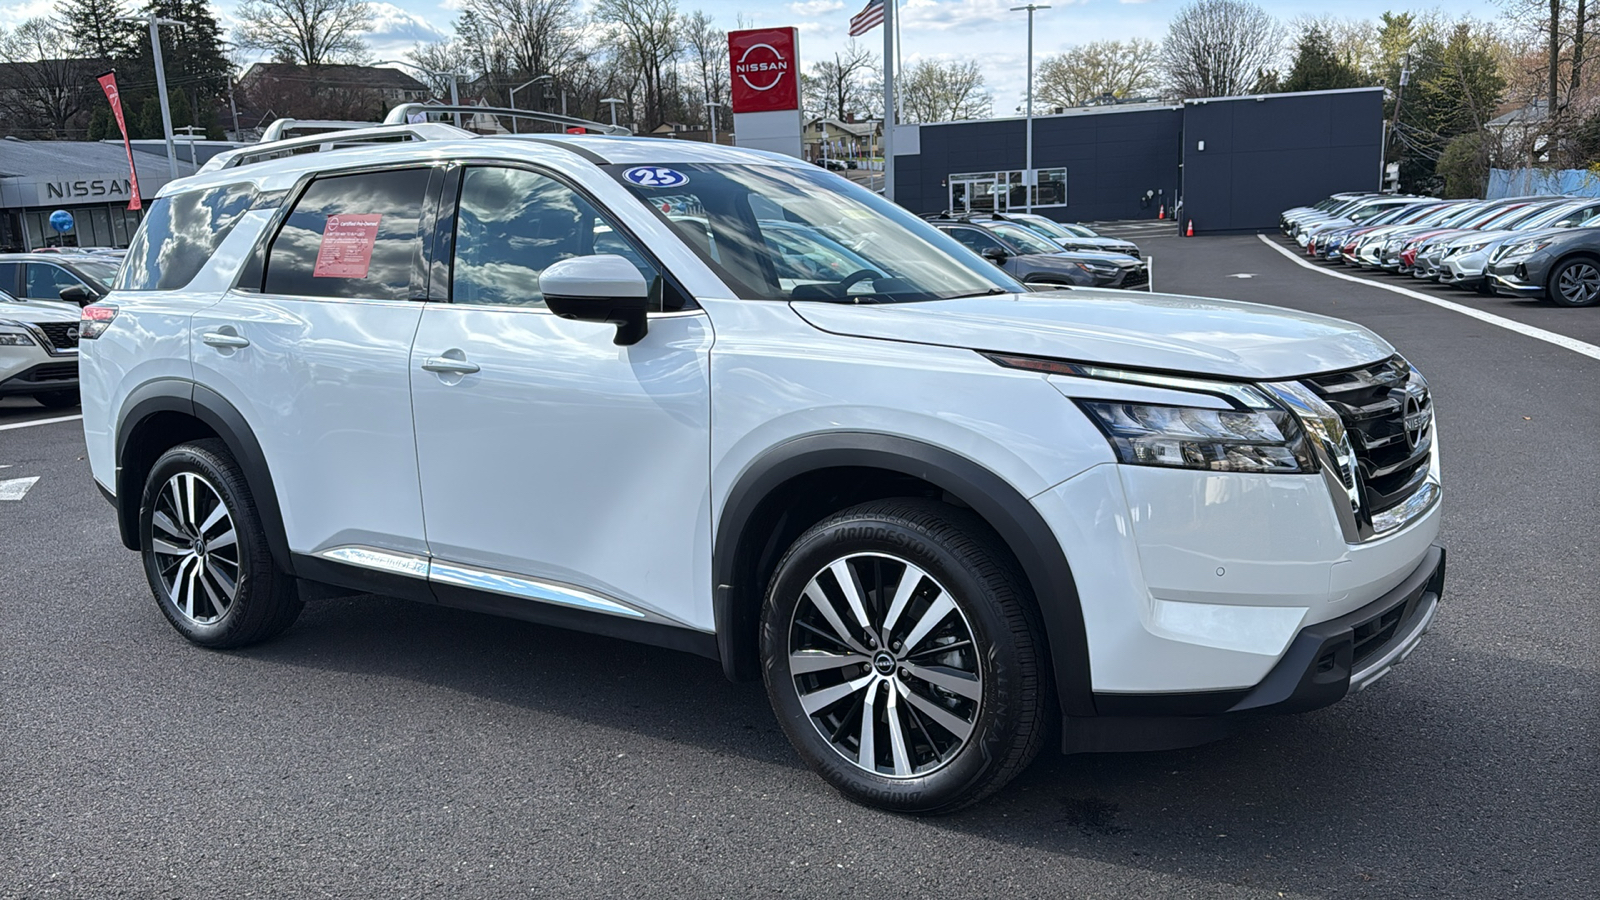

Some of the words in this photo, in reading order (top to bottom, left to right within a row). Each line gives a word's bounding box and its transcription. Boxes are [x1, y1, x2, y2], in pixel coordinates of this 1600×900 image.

[736, 61, 787, 73] NISSAN
[634, 168, 676, 186] 25
[833, 526, 945, 567] BRIDGESTONE
